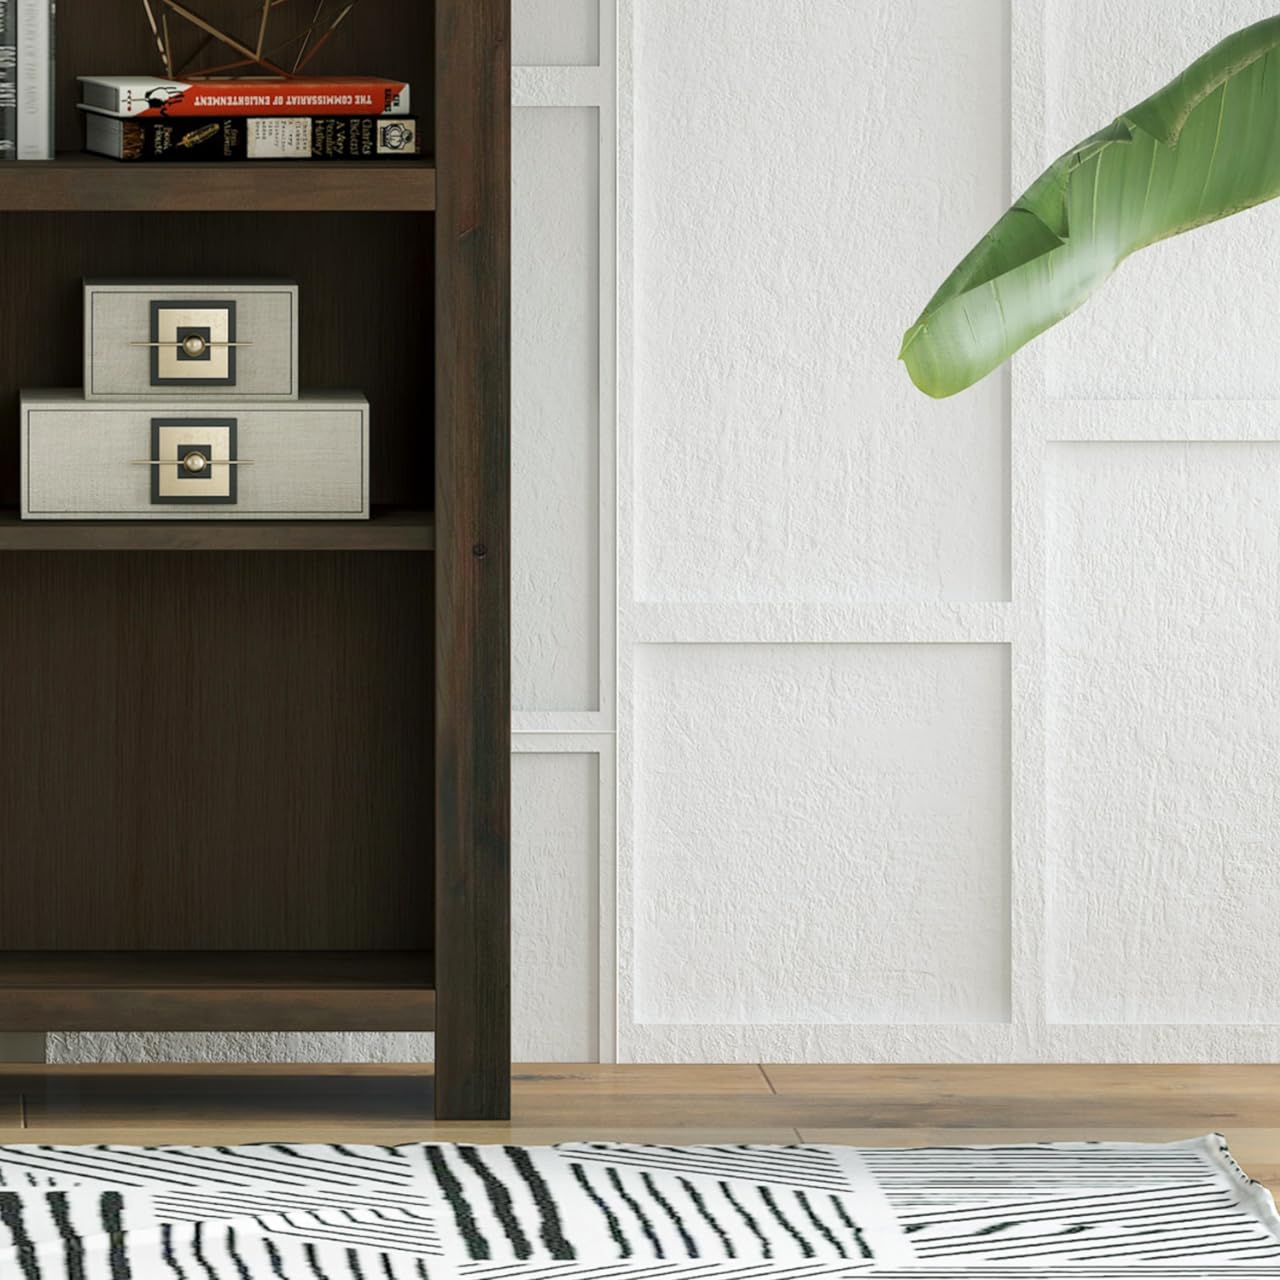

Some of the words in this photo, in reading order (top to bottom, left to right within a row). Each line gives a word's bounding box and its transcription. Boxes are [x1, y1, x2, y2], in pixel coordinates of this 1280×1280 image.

[194, 95, 270, 106] ENLIGHTENMENT
[274, 95, 283, 106] OF
[286, 95, 352, 106] COMMISSARIAT
[356, 95, 372, 106] THE
